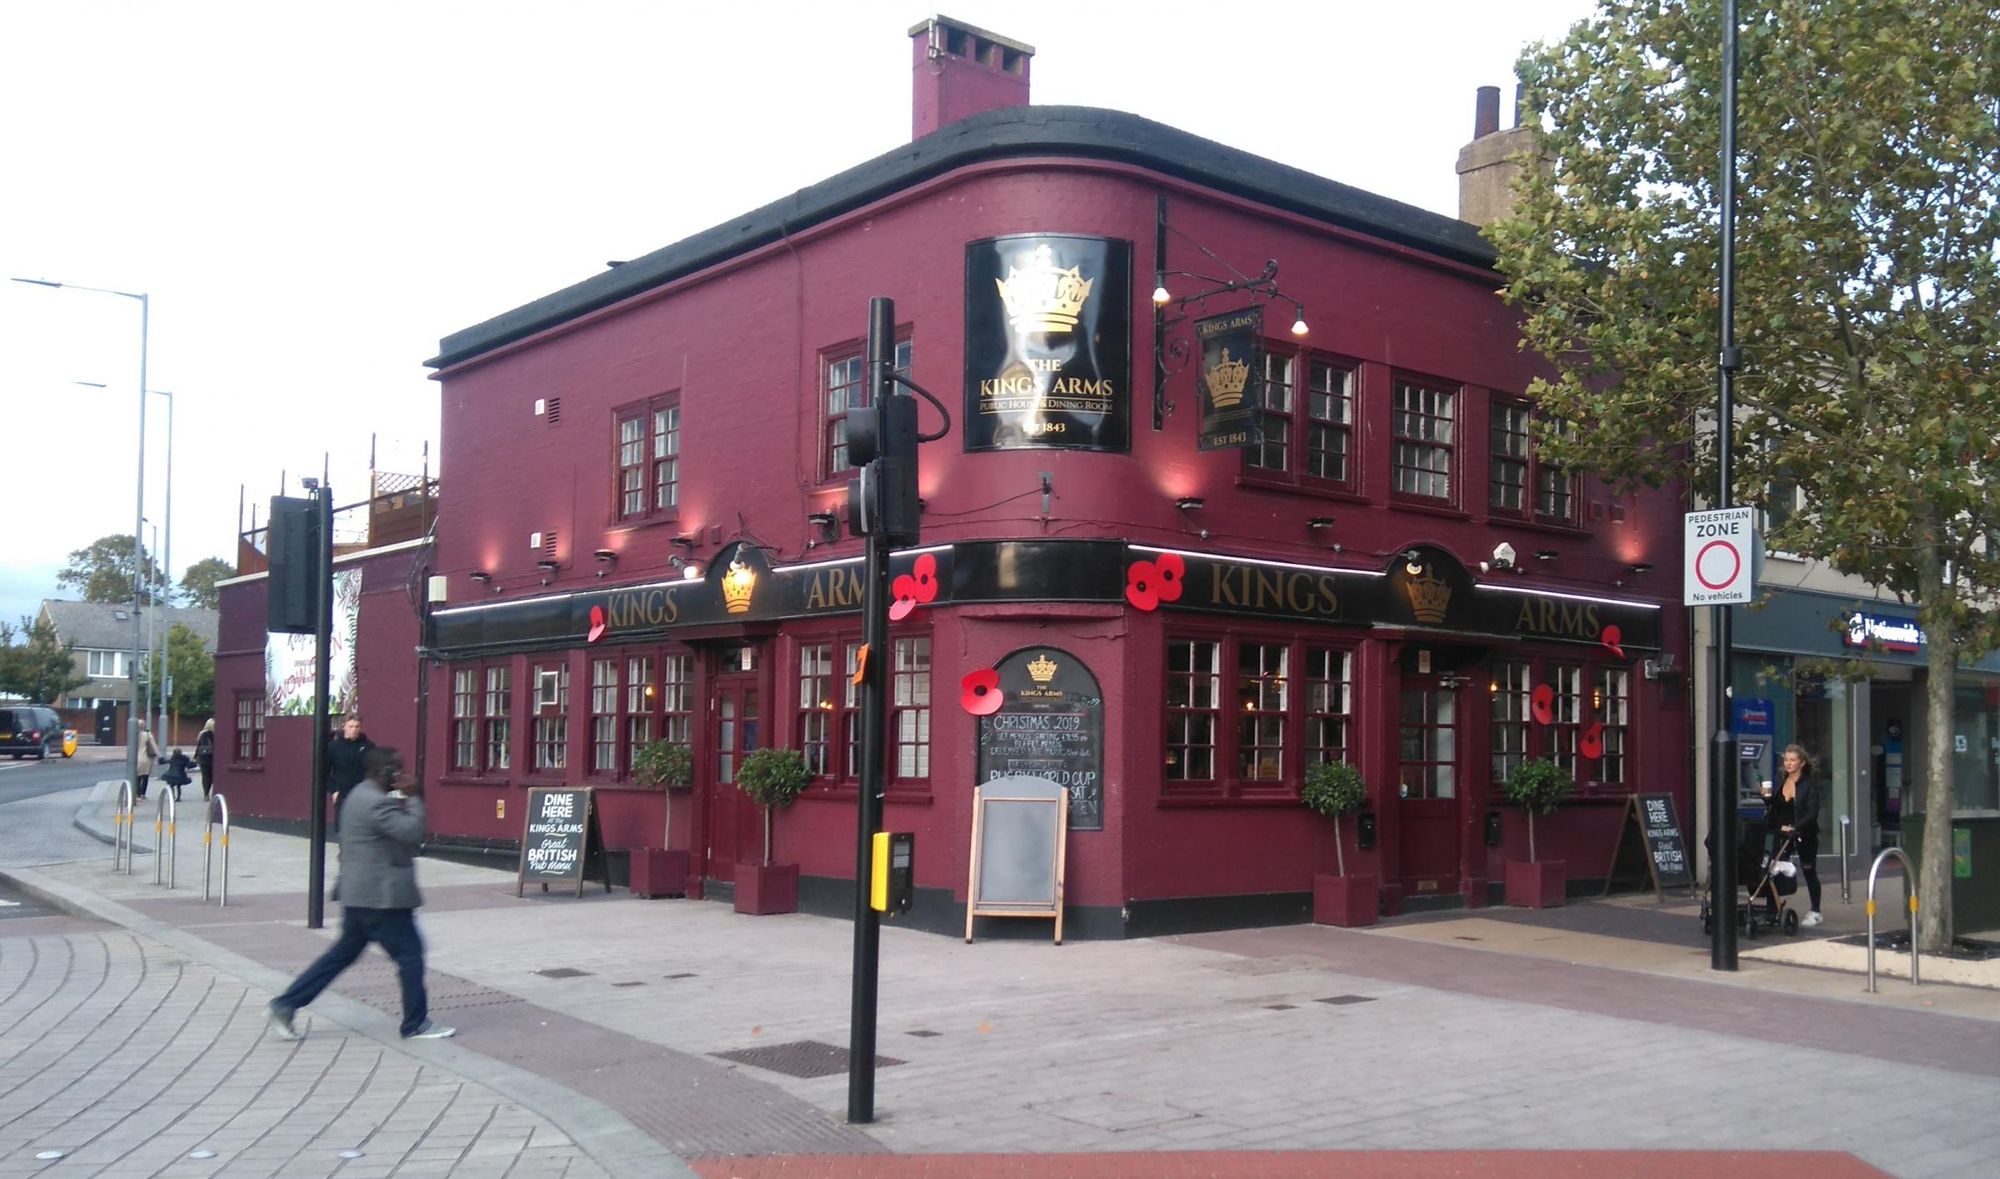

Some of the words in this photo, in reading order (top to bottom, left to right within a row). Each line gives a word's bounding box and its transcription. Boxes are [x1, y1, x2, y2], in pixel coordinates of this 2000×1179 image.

[1202, 320, 1227, 334] KINGS
[1230, 315, 1253, 329] ARMS
[1032, 358, 1061, 372] THE
[980, 377, 1044, 397] KINGS
[1052, 377, 1113, 396] ARMS
[980, 402, 1007, 411] PUBLIC
[1009, 401, 1037, 410] HOUS
[1048, 400, 1083, 410] DINING
[1085, 401, 1113, 410] ROOM
[1042, 422, 1066, 432] 1843
[1213, 436, 1227, 446] EST
[1229, 432, 1246, 443] 1843
[1688, 511, 1749, 524] PEDESTRIAN
[1696, 522, 1740, 538] ZONE
[606, 588, 678, 627] KINGS
[807, 566, 866, 609] ARM
[1210, 562, 1337, 615] KINGS
[1515, 597, 1600, 638] ARMS
[1693, 593, 1705, 601] No
[1707, 591, 1743, 600] vehicles
[993, 715, 1050, 730] CHRISTMAS
[1053, 716, 1080, 730] 2019
[1072, 771, 1096, 786] CUP
[544, 793, 573, 806] DINE
[1646, 799, 1666, 812] DINE
[541, 805, 573, 818] HERE
[1649, 811, 1669, 823] HERE
[529, 823, 557, 833] KINGS
[557, 823, 584, 833] ARMS
[541, 837, 568, 849] Great
[528, 848, 577, 861] BRITISH
[1653, 850, 1683, 863] BRITISH
[529, 860, 547, 870] Pub
[547, 860, 572, 870] Menu
